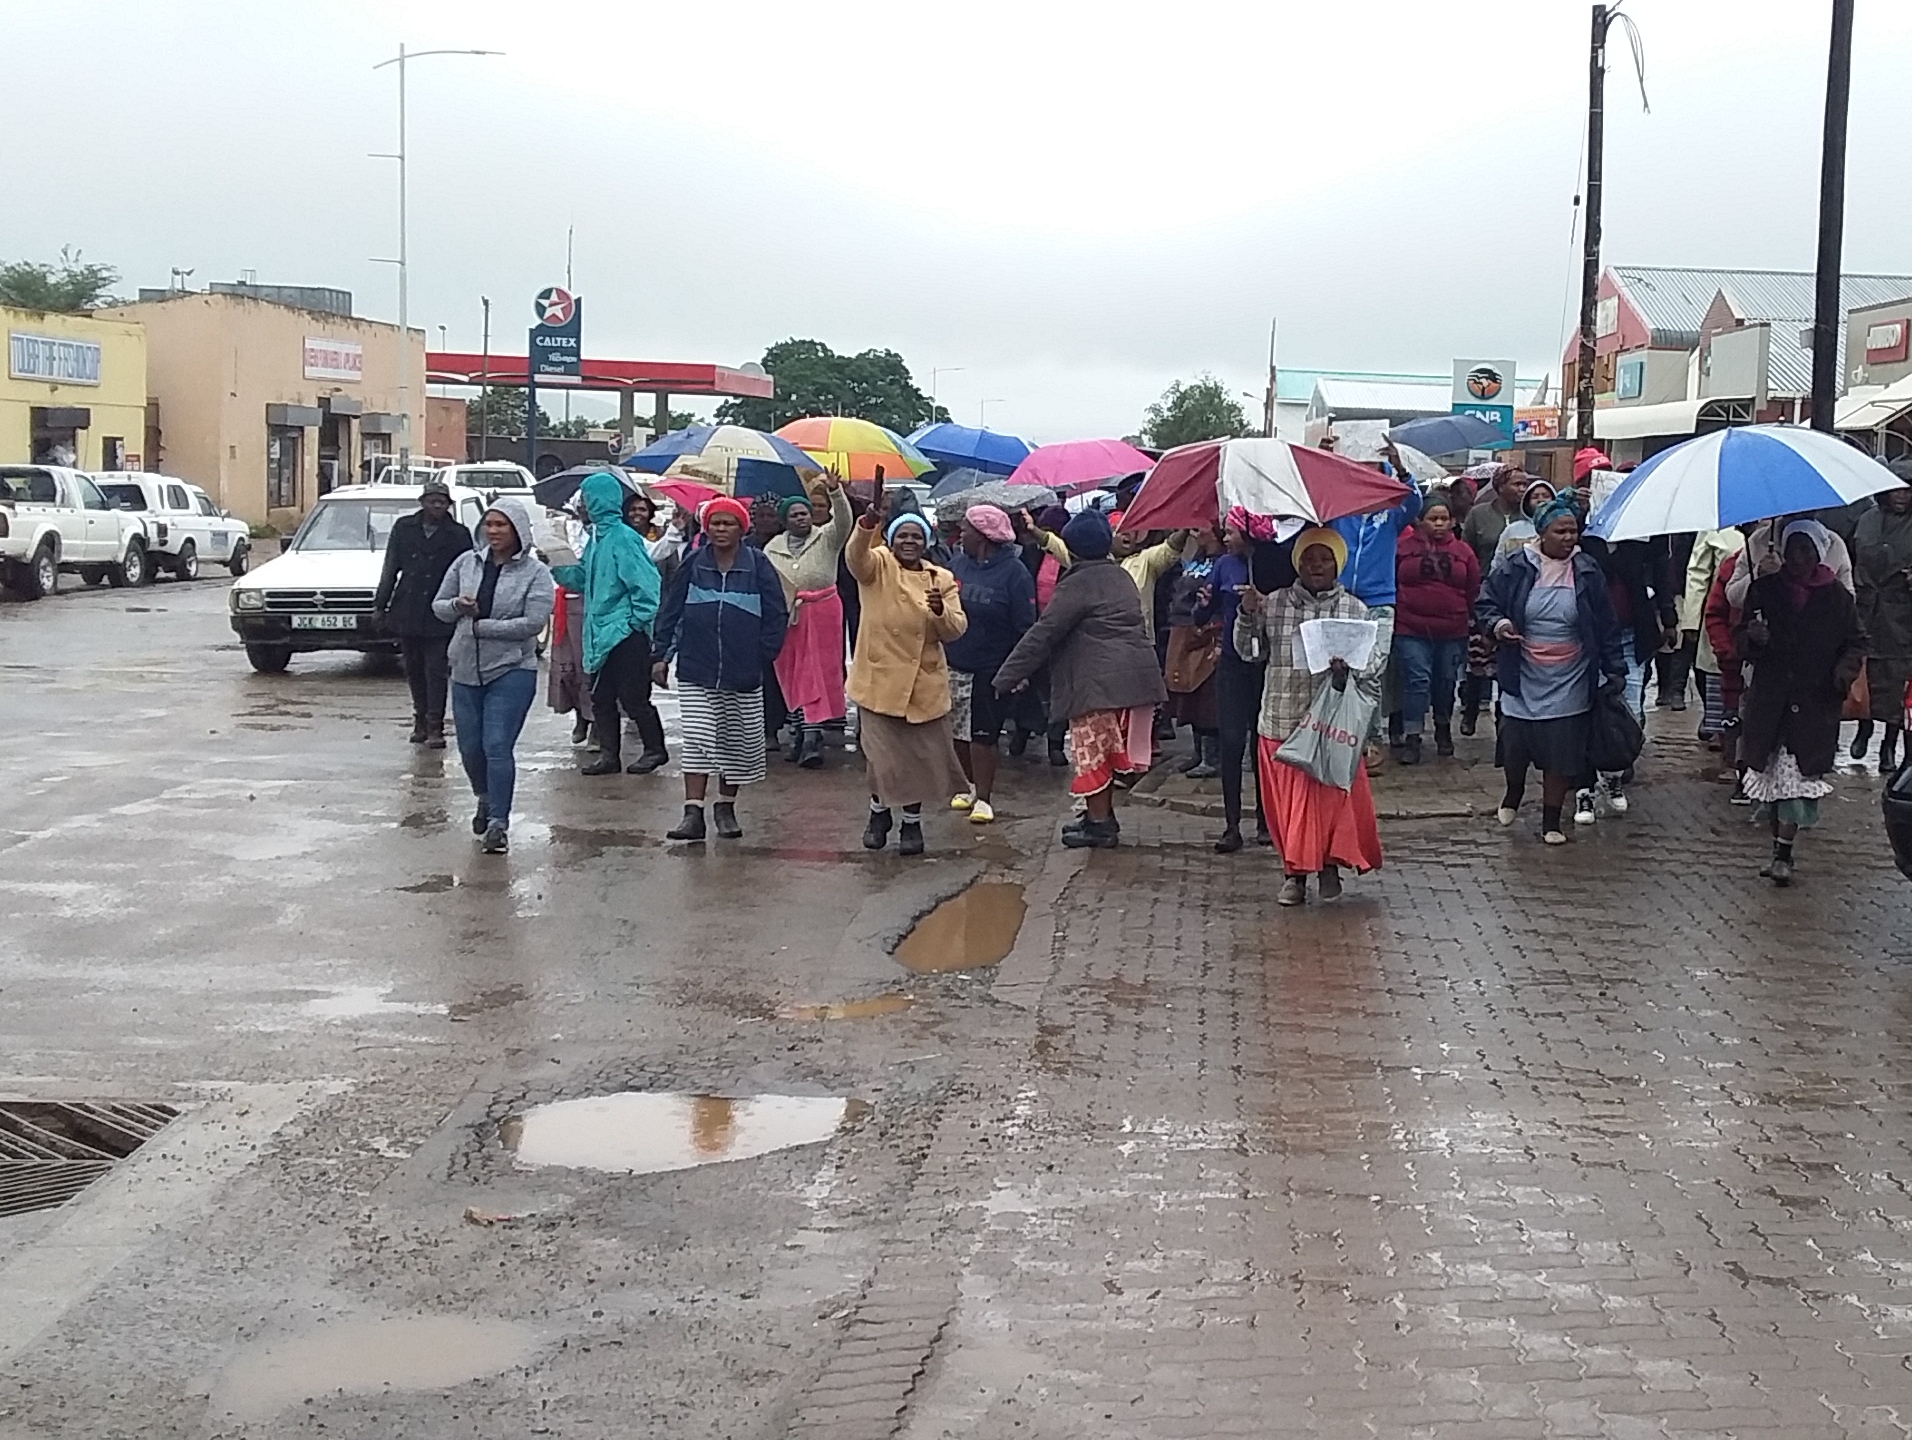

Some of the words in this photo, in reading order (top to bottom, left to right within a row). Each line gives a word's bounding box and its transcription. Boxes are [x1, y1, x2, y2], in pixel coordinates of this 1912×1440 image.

[536, 336, 577, 348] CALTEX
[540, 364, 565, 373] Diesel
[297, 616, 314, 628] JCK
[320, 616, 338, 627] 652
[1311, 719, 1358, 748] JUMBO
